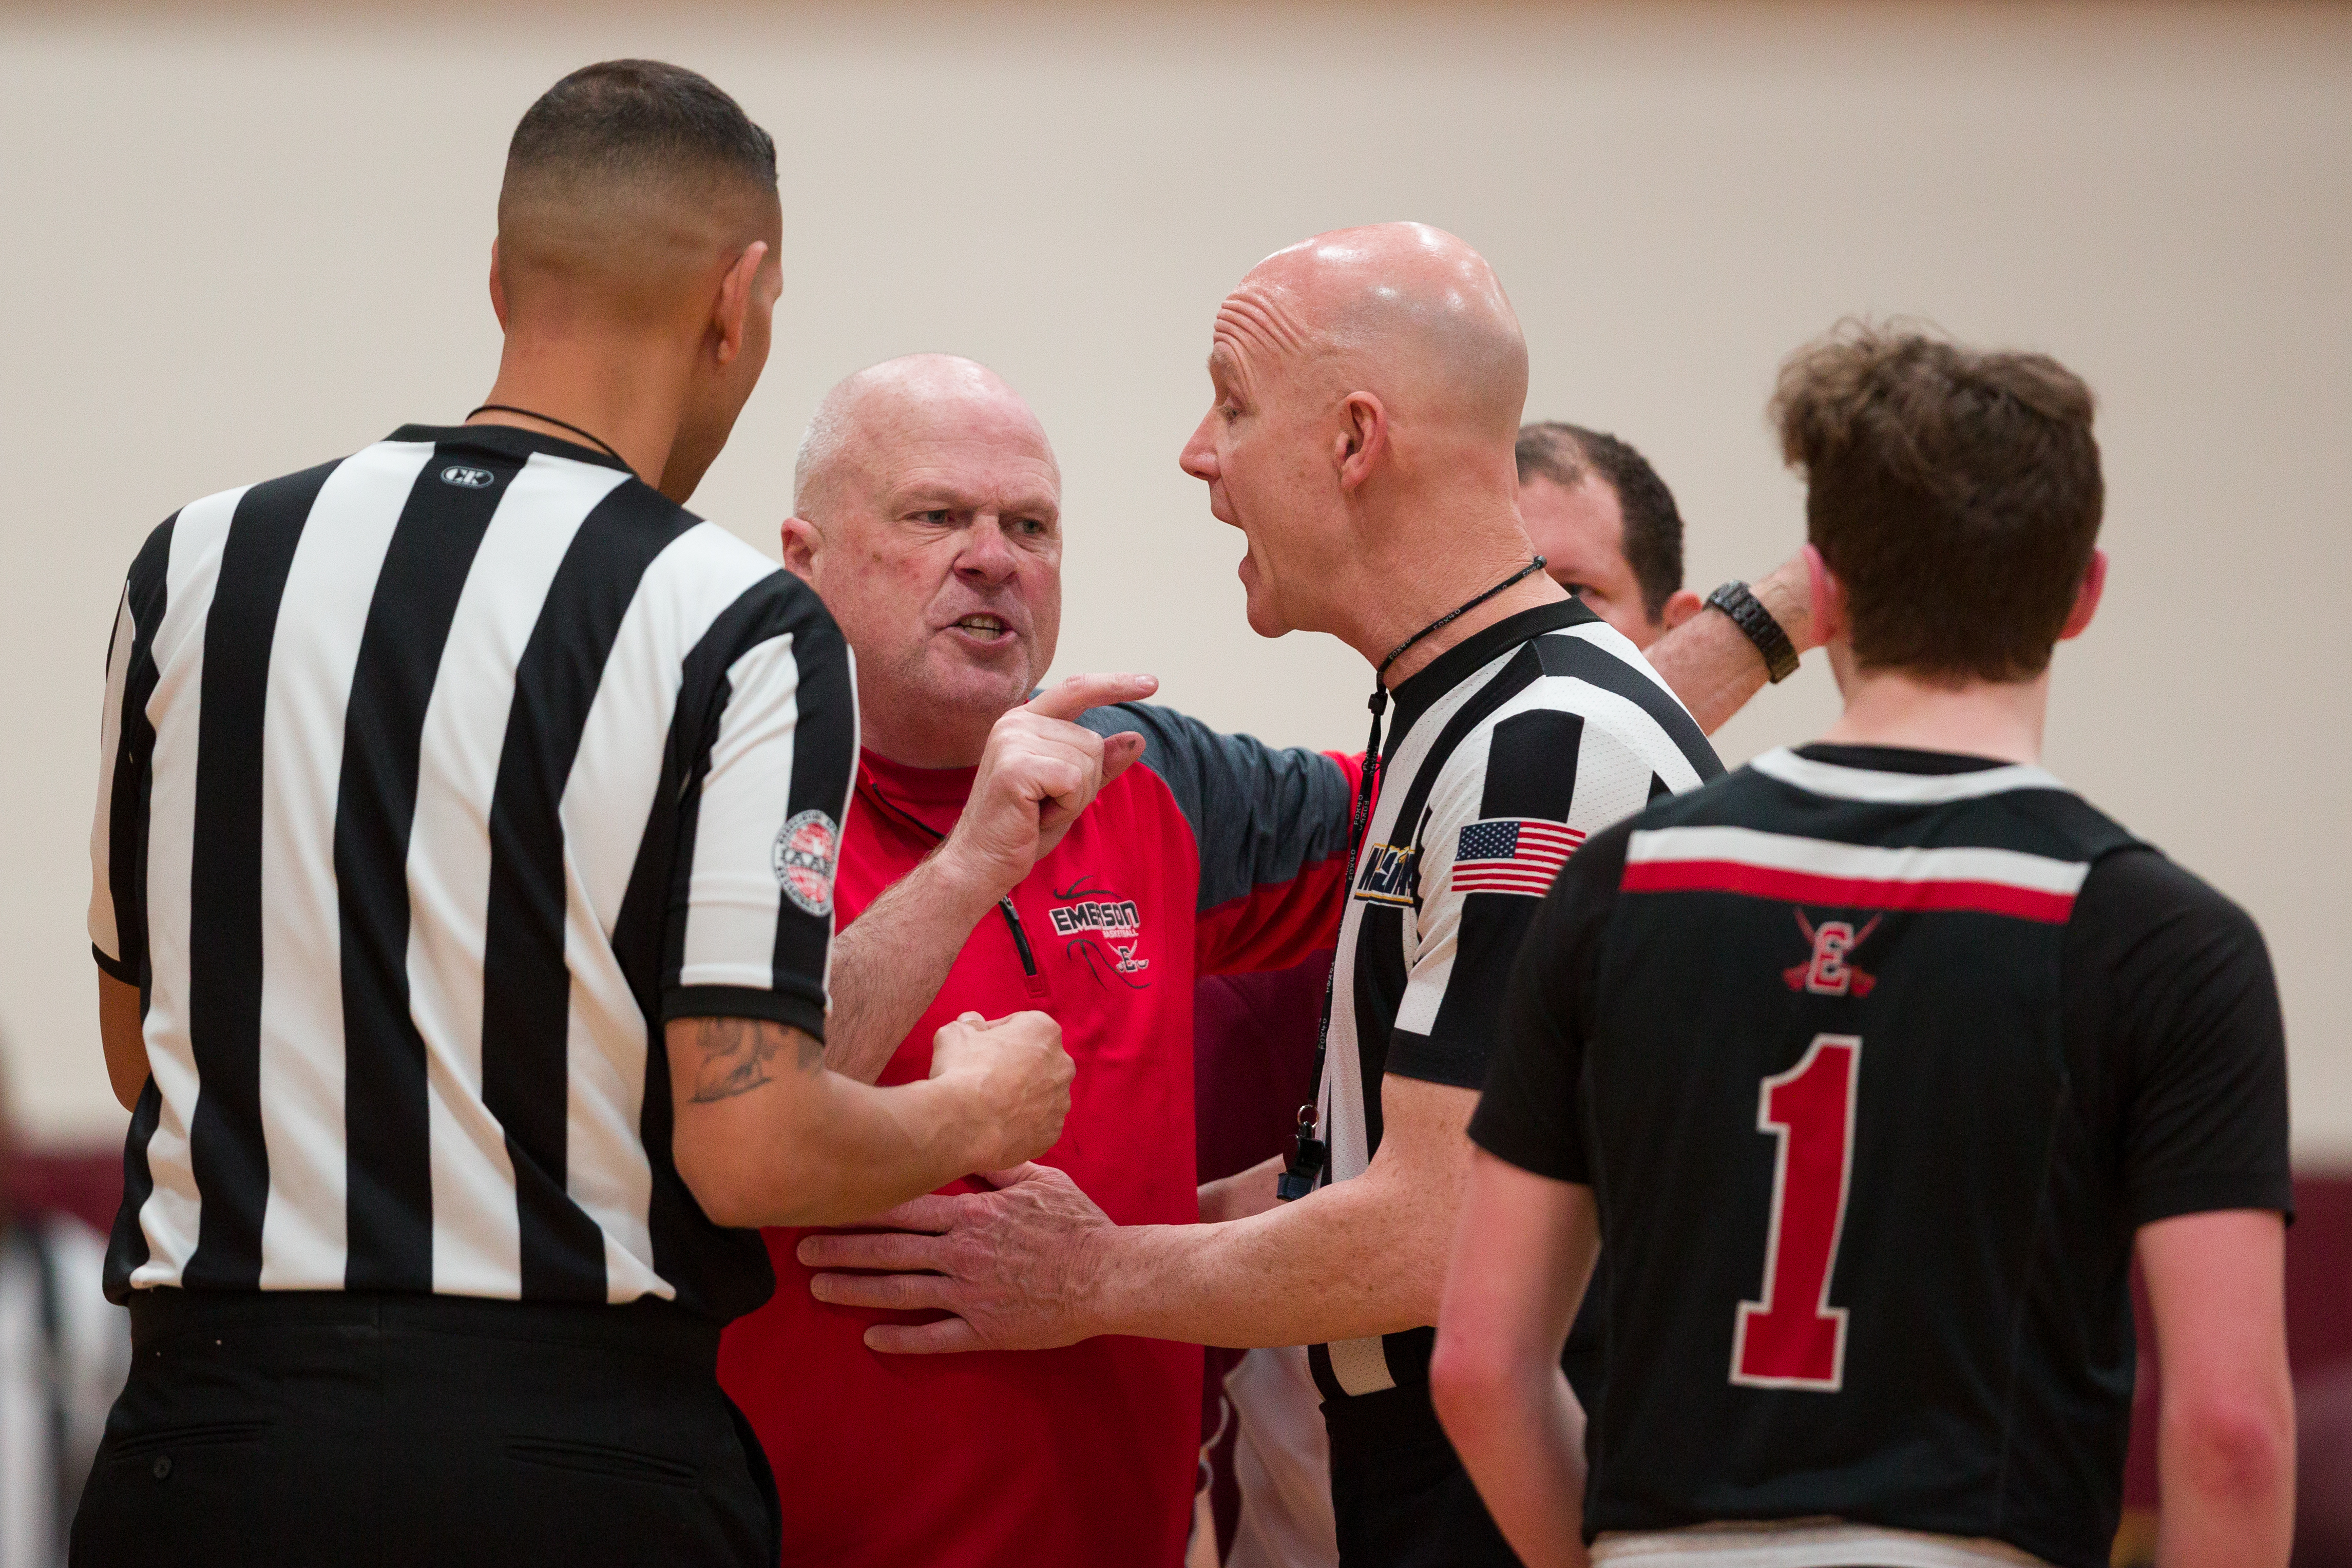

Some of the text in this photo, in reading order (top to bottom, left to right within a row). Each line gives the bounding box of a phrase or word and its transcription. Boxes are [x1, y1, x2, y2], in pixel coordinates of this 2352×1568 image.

[1432, 609, 1460, 629] FOX40
[1388, 638, 1410, 660] FOX40
[1354, 794, 1363, 825] FOX40
[1049, 900, 1141, 936] EMERSON
[1103, 929, 1139, 938] BASKETBALL
[1806, 920, 1854, 997] E
[1728, 1032, 1863, 1393] 1
